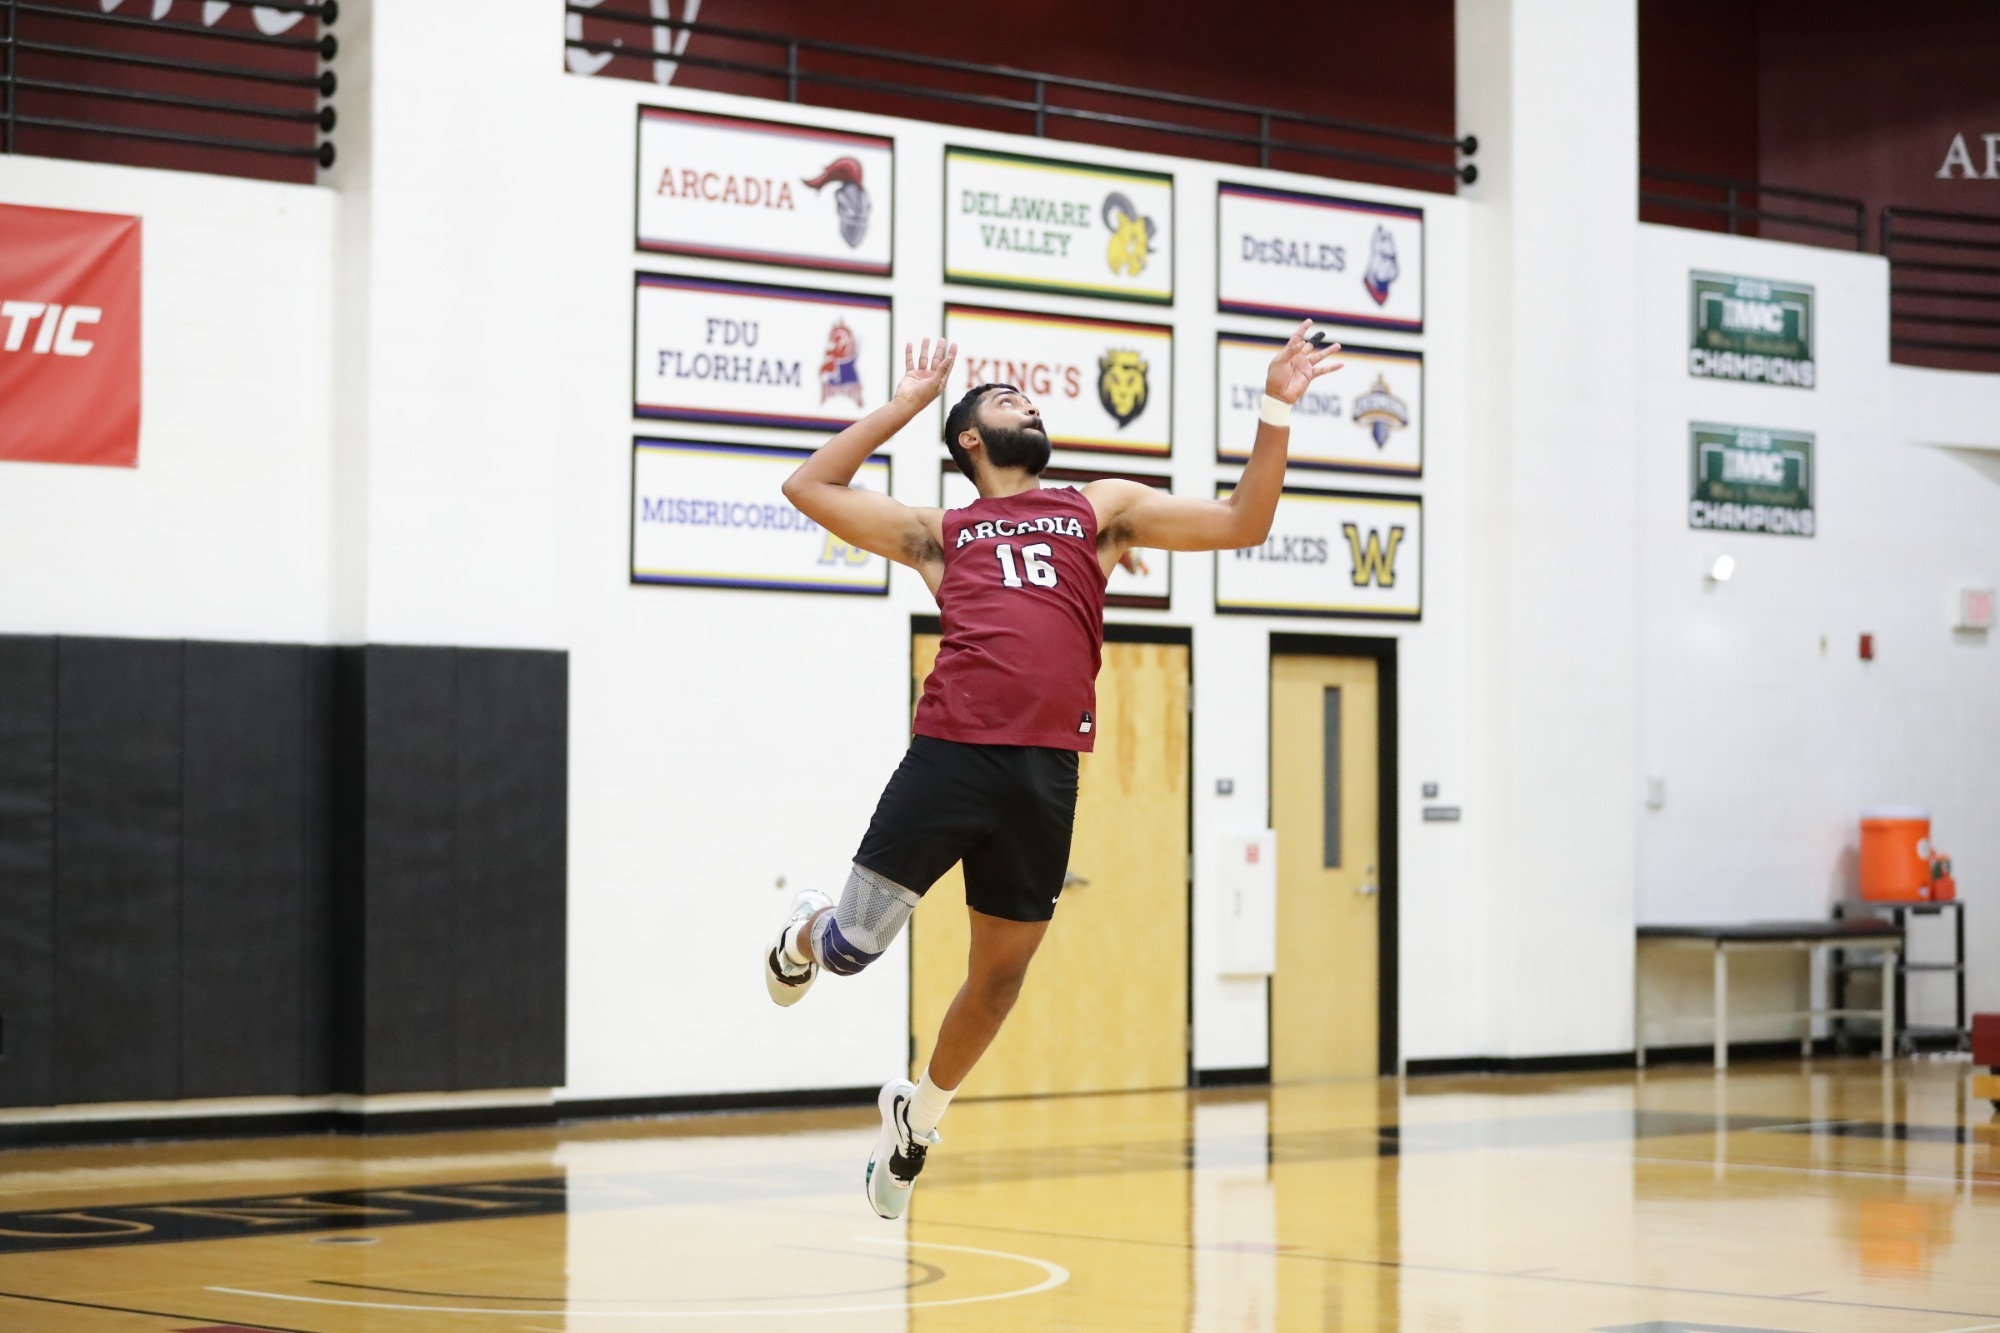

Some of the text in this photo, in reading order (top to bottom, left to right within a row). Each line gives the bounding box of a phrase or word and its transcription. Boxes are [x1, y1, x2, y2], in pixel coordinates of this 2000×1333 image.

[657, 167, 796, 211] ARCADIA
[961, 189, 1092, 228] DELAWARE
[979, 223, 1073, 257] VALLEY
[0, 300, 103, 358] TIC
[706, 318, 760, 348] FDU
[657, 350, 803, 388] FLORHAM
[965, 356, 1082, 399] KING'S
[1689, 348, 1814, 387] CHAMPIONS
[955, 516, 1087, 550] ARCADIA
[1689, 499, 1814, 536] CHAMPIONS
[995, 541, 1060, 590] 16
[1341, 522, 1406, 588] W
